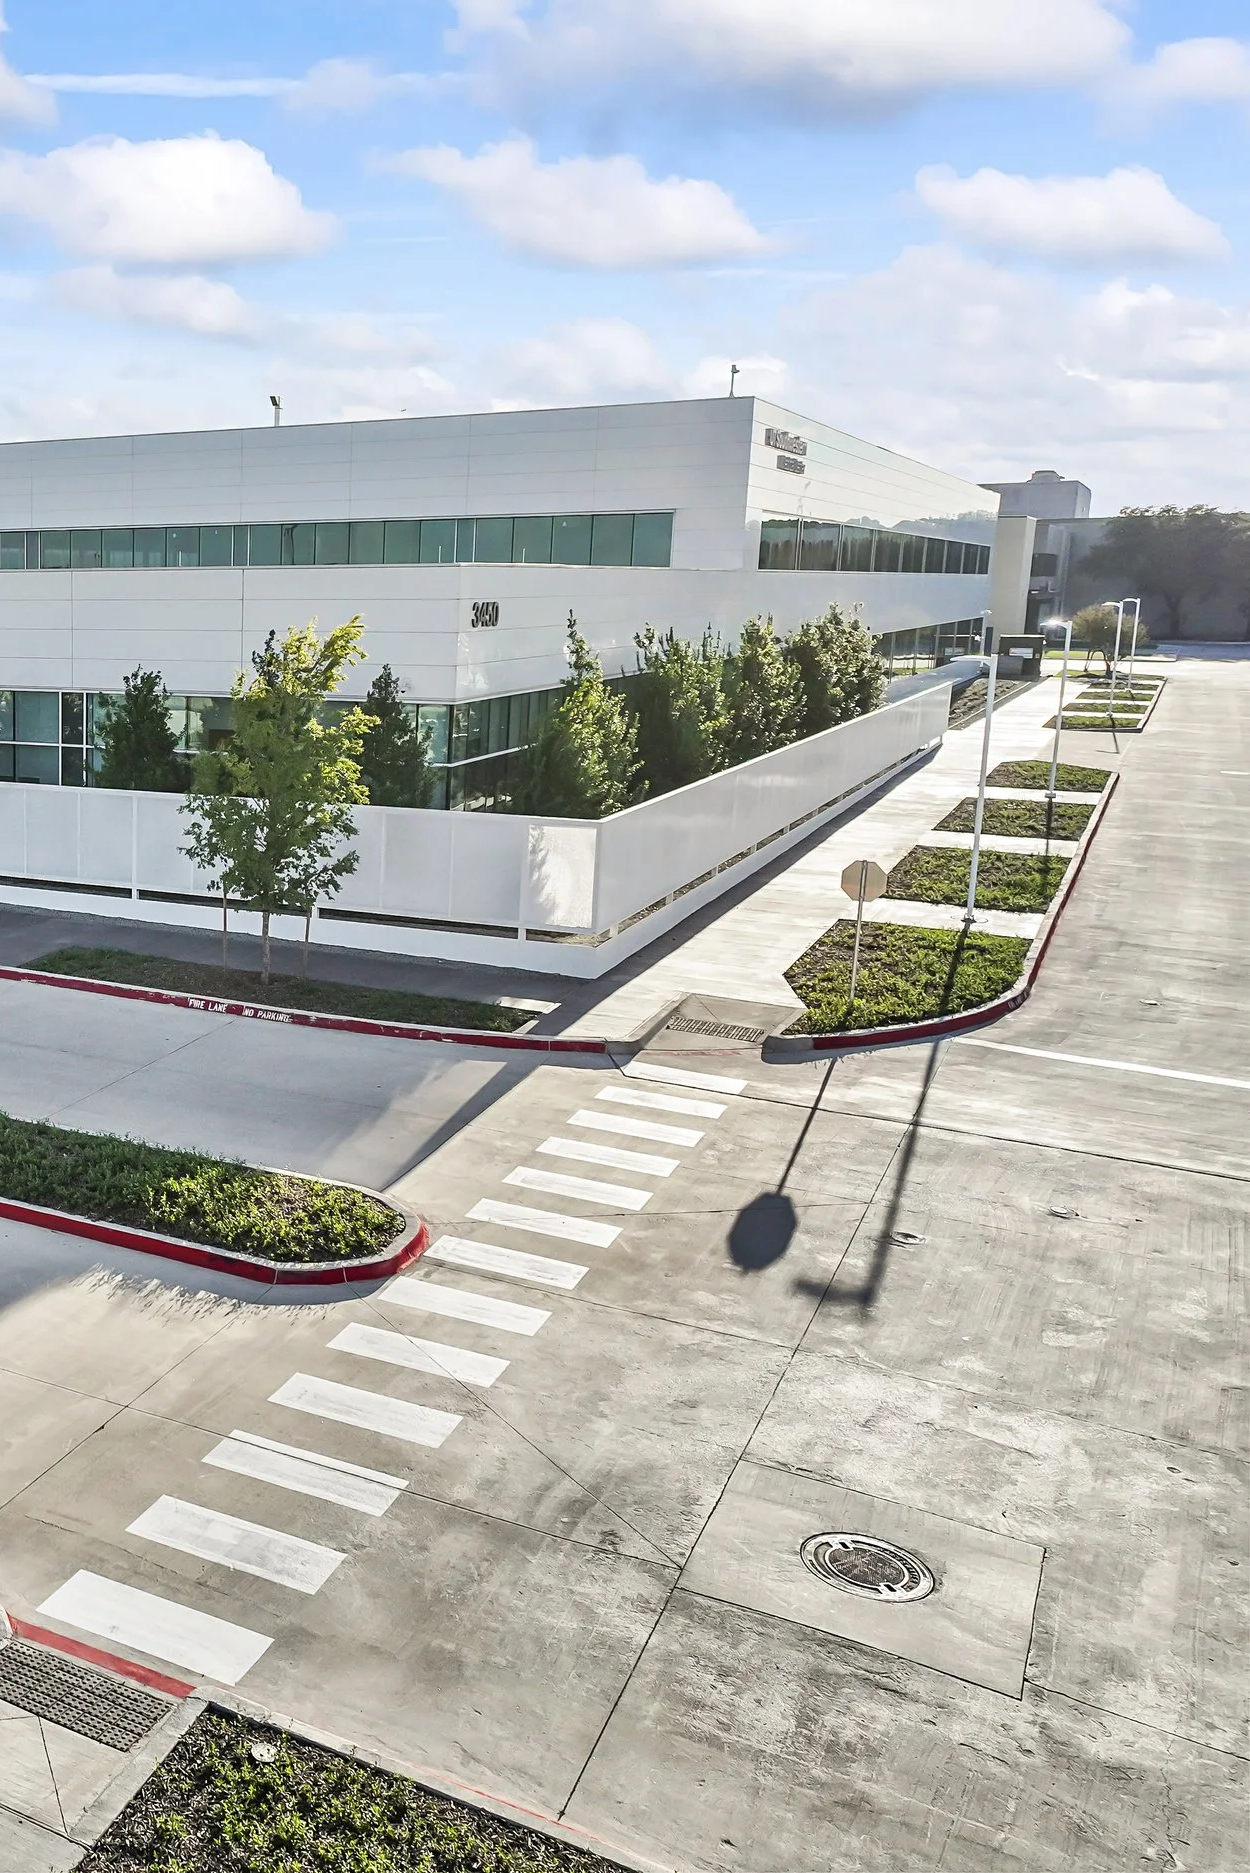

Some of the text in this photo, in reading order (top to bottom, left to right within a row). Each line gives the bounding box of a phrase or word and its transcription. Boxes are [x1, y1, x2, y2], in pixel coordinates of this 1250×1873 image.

[471, 601, 500, 628] 3450
[188, 999, 293, 1023] FIRE LANE NO PARKING
